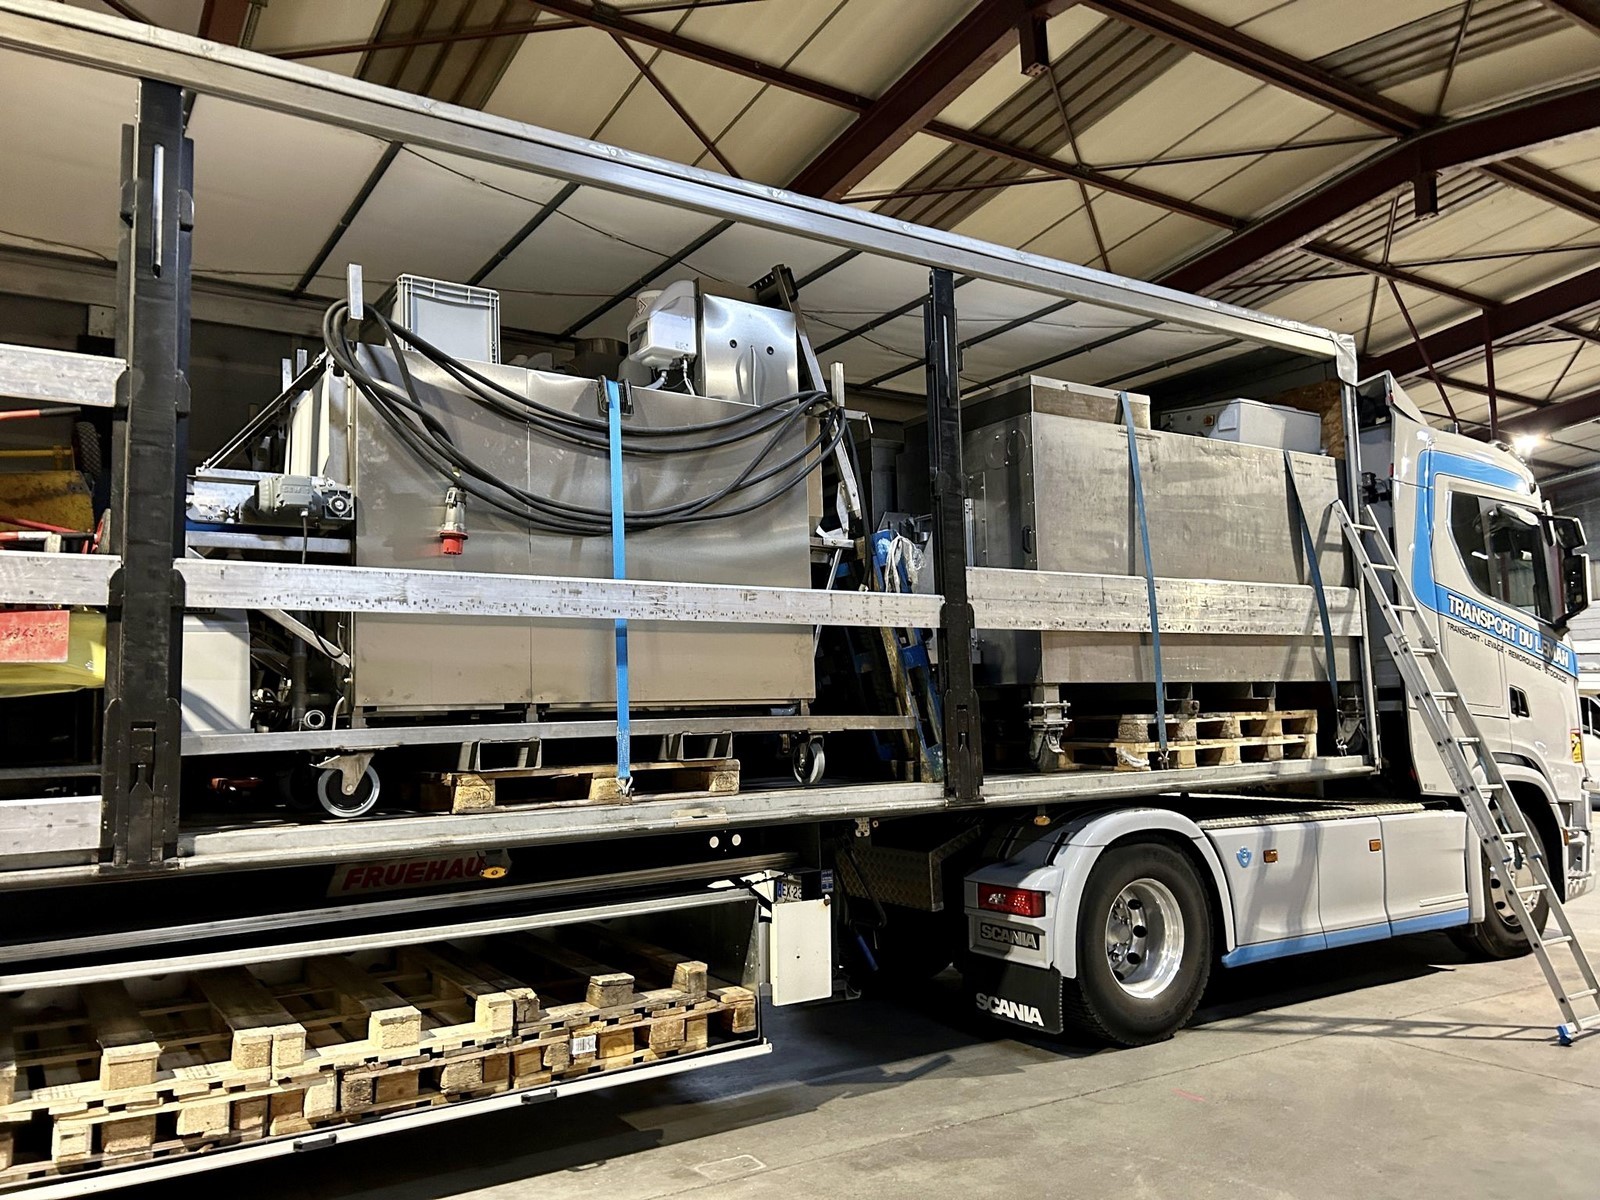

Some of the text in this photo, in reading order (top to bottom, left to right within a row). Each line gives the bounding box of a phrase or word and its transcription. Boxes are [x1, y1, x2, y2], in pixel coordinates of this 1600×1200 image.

[1447, 594, 1517, 641] TRANSPORT
[1519, 628, 1533, 649] DU
[1446, 621, 1480, 642] TRANSPORT
[1484, 638, 1504, 653] LEVAGE
[1508, 649, 1542, 671] REMORQUAGE
[341, 855, 487, 891] FRUEHAU
[981, 925, 1037, 948] SCANIA
[975, 992, 1045, 1027] SCANIA
